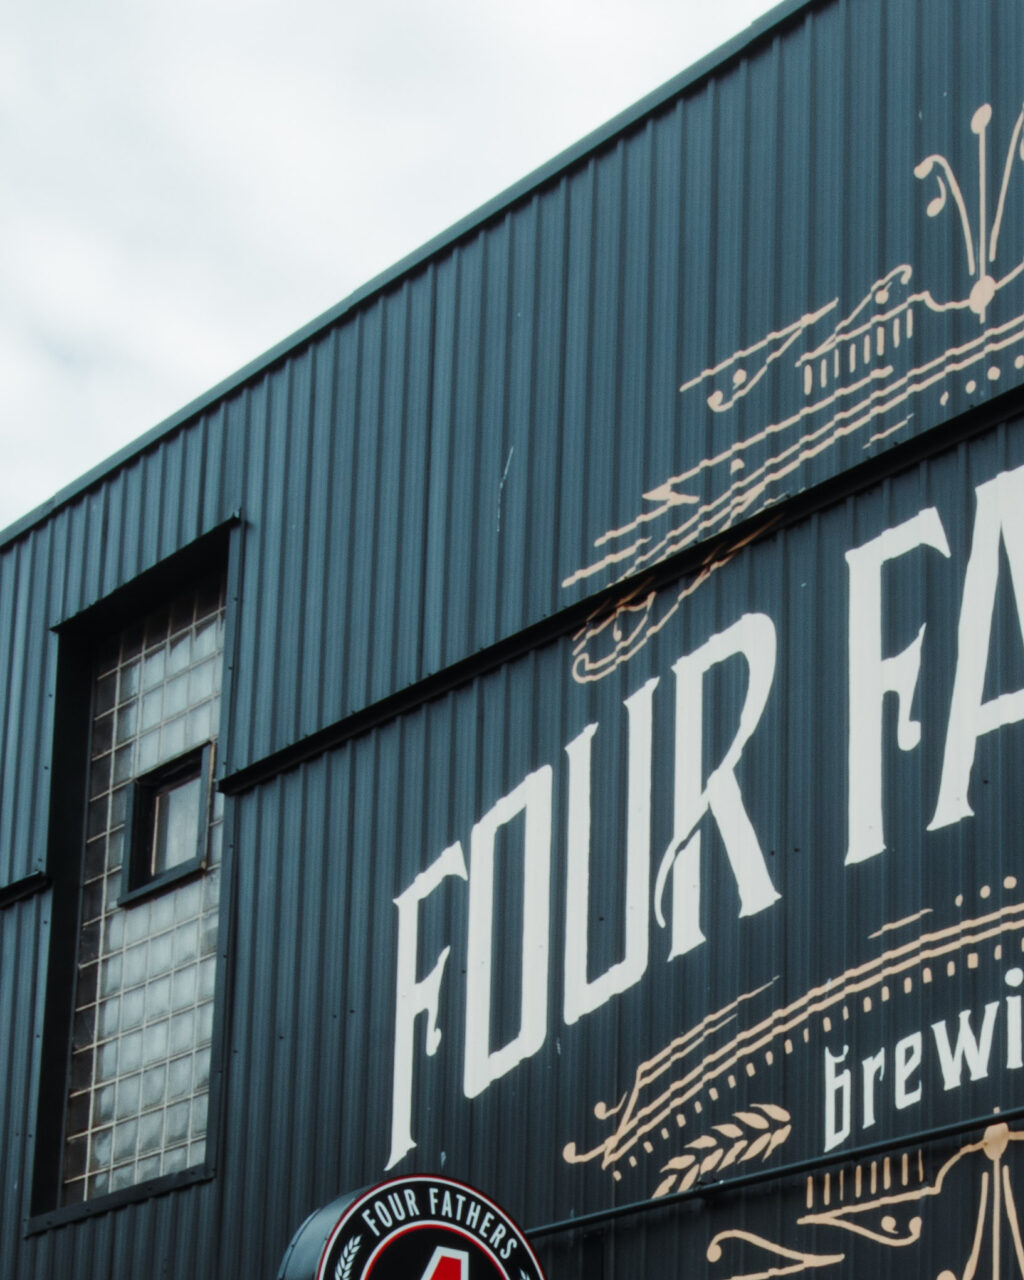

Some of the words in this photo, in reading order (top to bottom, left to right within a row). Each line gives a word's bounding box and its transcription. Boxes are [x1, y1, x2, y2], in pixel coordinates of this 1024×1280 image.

[384, 612, 782, 1171] FOUR
[361, 1188, 420, 1237] FOUR
[428, 1187, 518, 1260] FATHERS
